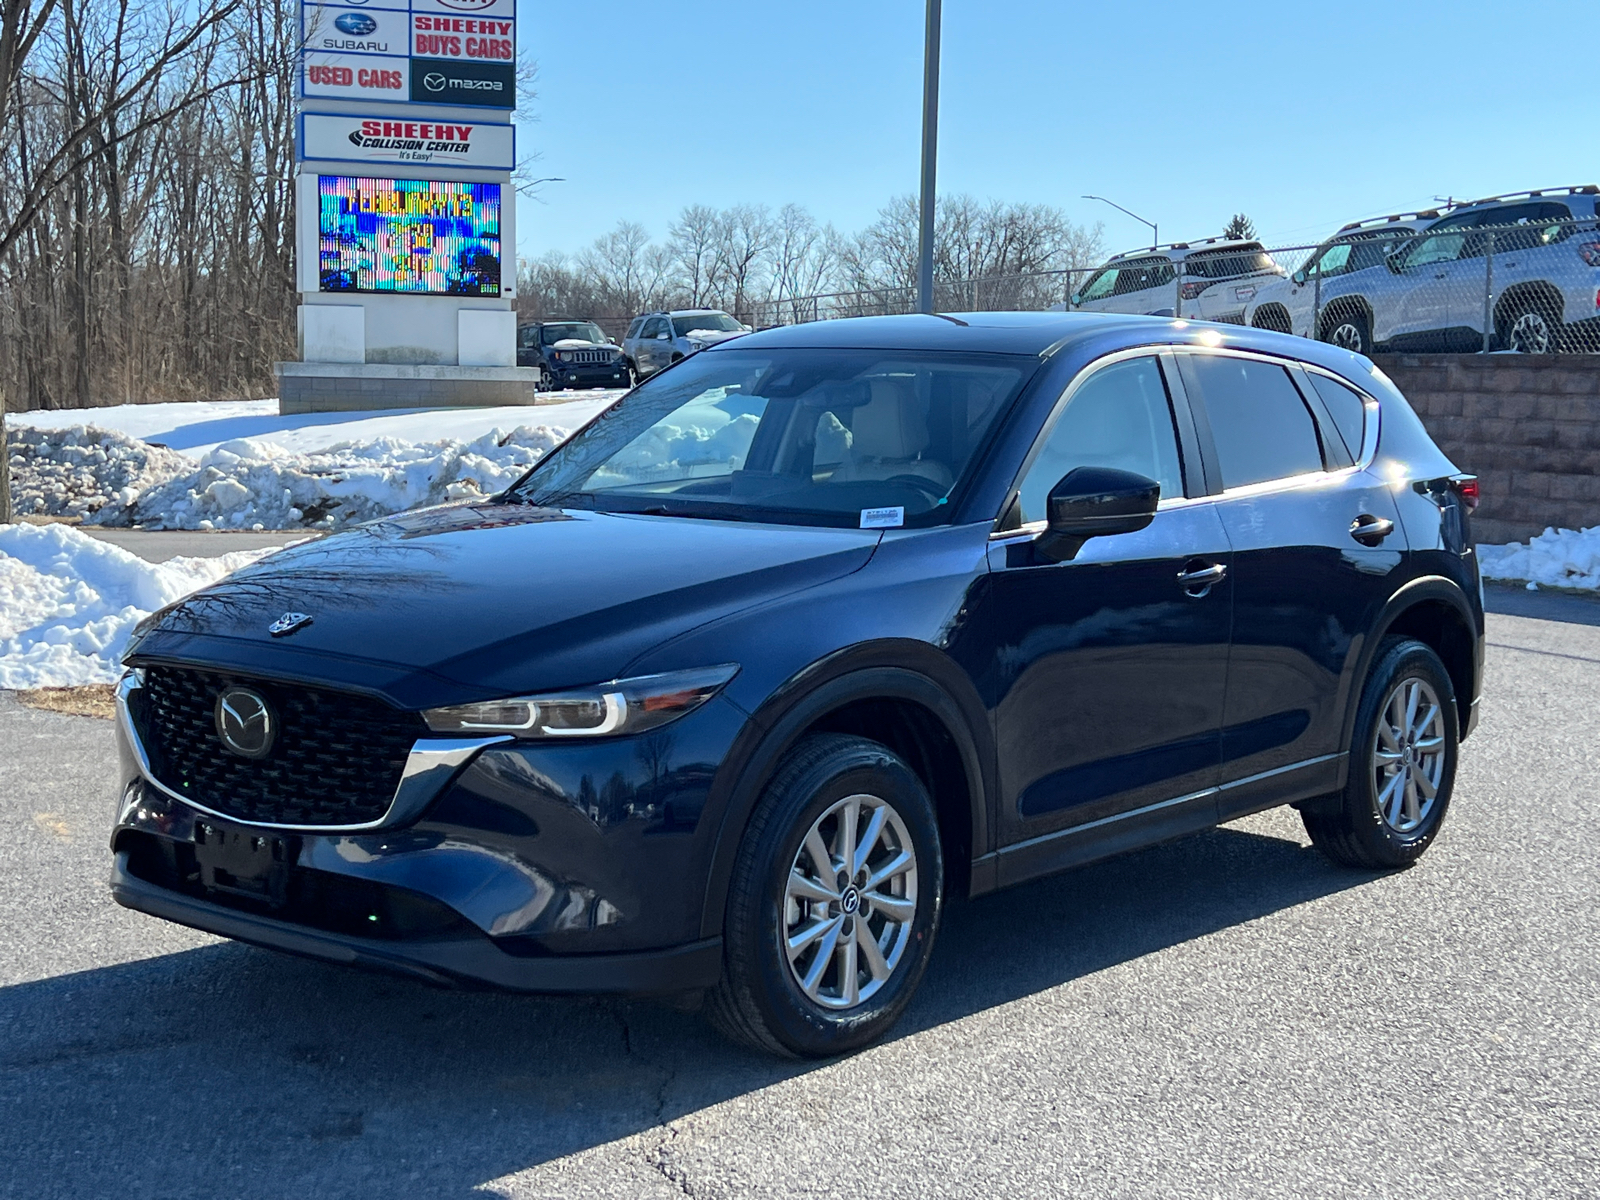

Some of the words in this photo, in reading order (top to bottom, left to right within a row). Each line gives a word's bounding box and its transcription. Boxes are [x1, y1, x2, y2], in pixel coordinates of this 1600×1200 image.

[415, 17, 512, 36] SHEEHY
[323, 38, 388, 52] SUBARU
[416, 33, 461, 57] BUYS
[465, 36, 512, 60] CARS
[309, 65, 353, 86] USED
[357, 68, 403, 90] CARS
[362, 121, 473, 142] SHEEHY
[362, 138, 425, 151] COLLISION
[428, 141, 471, 153] CENTER
[399, 151, 411, 160] It's
[411, 152, 433, 162] Easy!
